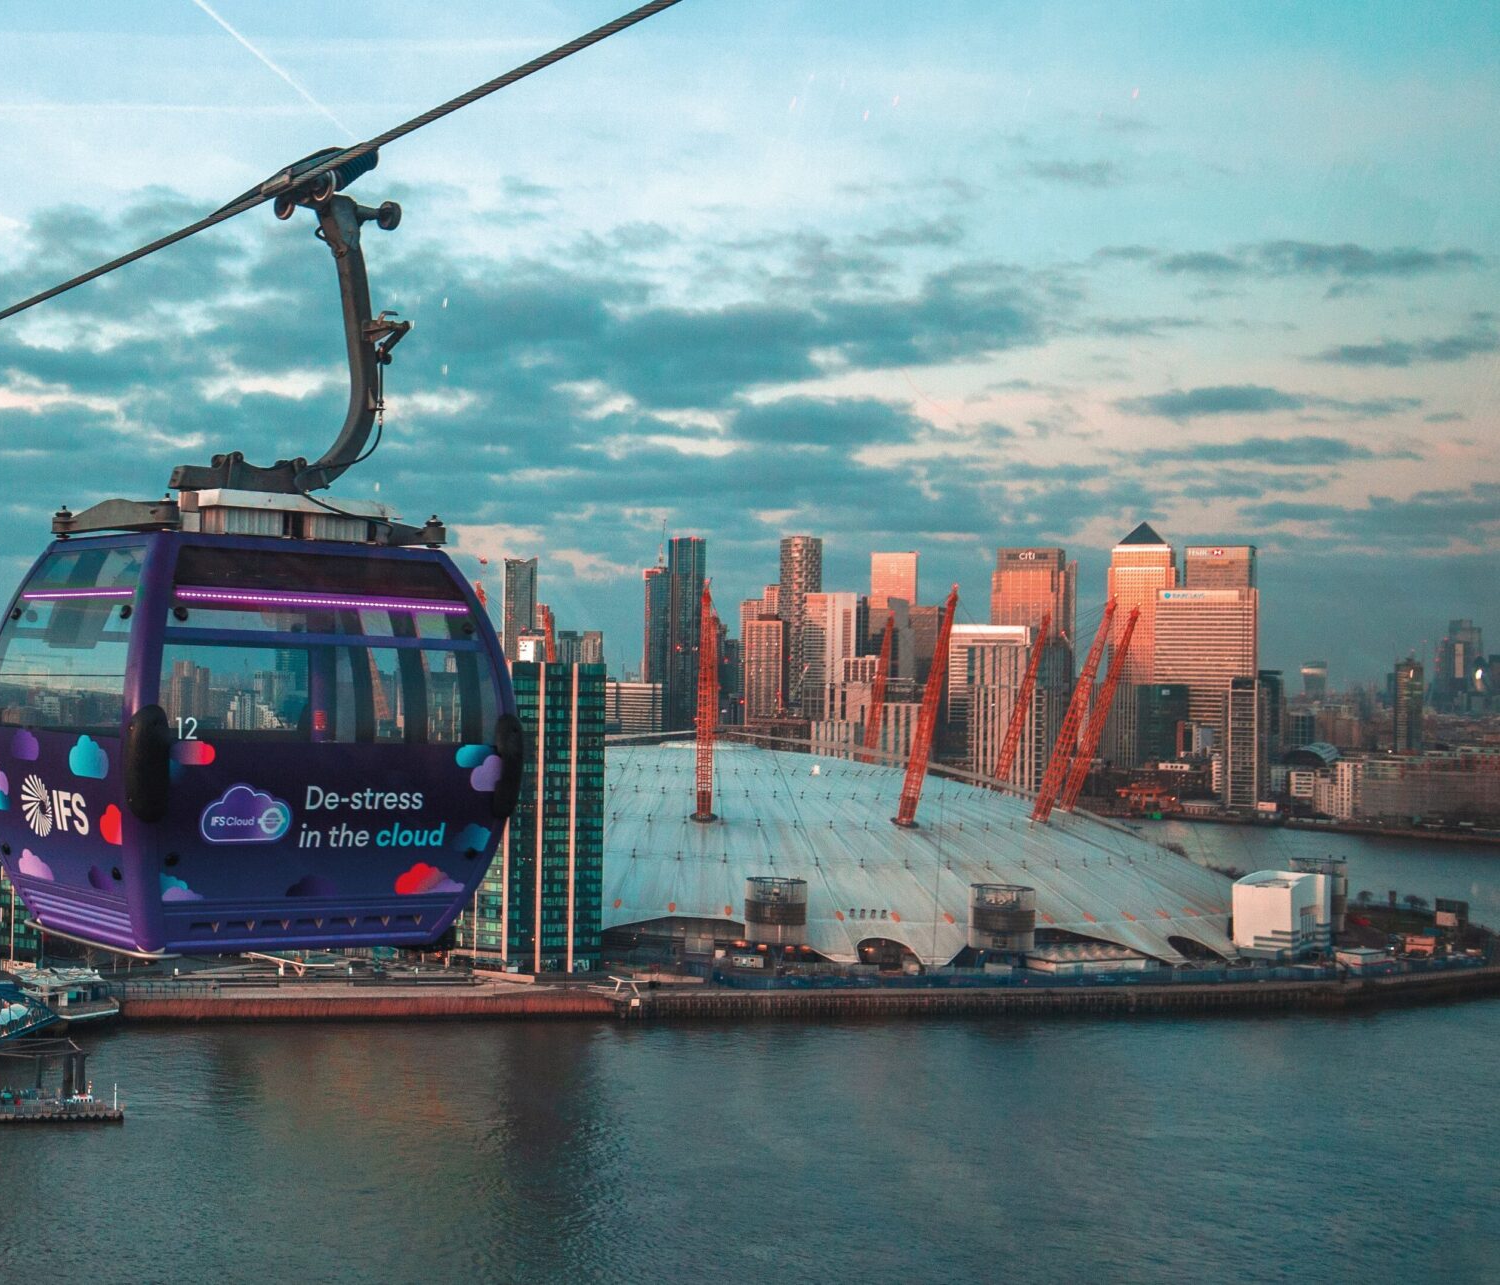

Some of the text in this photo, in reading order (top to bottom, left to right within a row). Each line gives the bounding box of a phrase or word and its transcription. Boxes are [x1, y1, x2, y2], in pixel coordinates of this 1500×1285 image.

[1018, 551, 1036, 560] citi
[175, 716, 198, 740] 12
[305, 785, 424, 810] De-stress
[52, 789, 90, 836] IFS
[211, 816, 225, 827] IFS
[226, 816, 256, 827] Cloud
[299, 822, 447, 848] in the cloud
